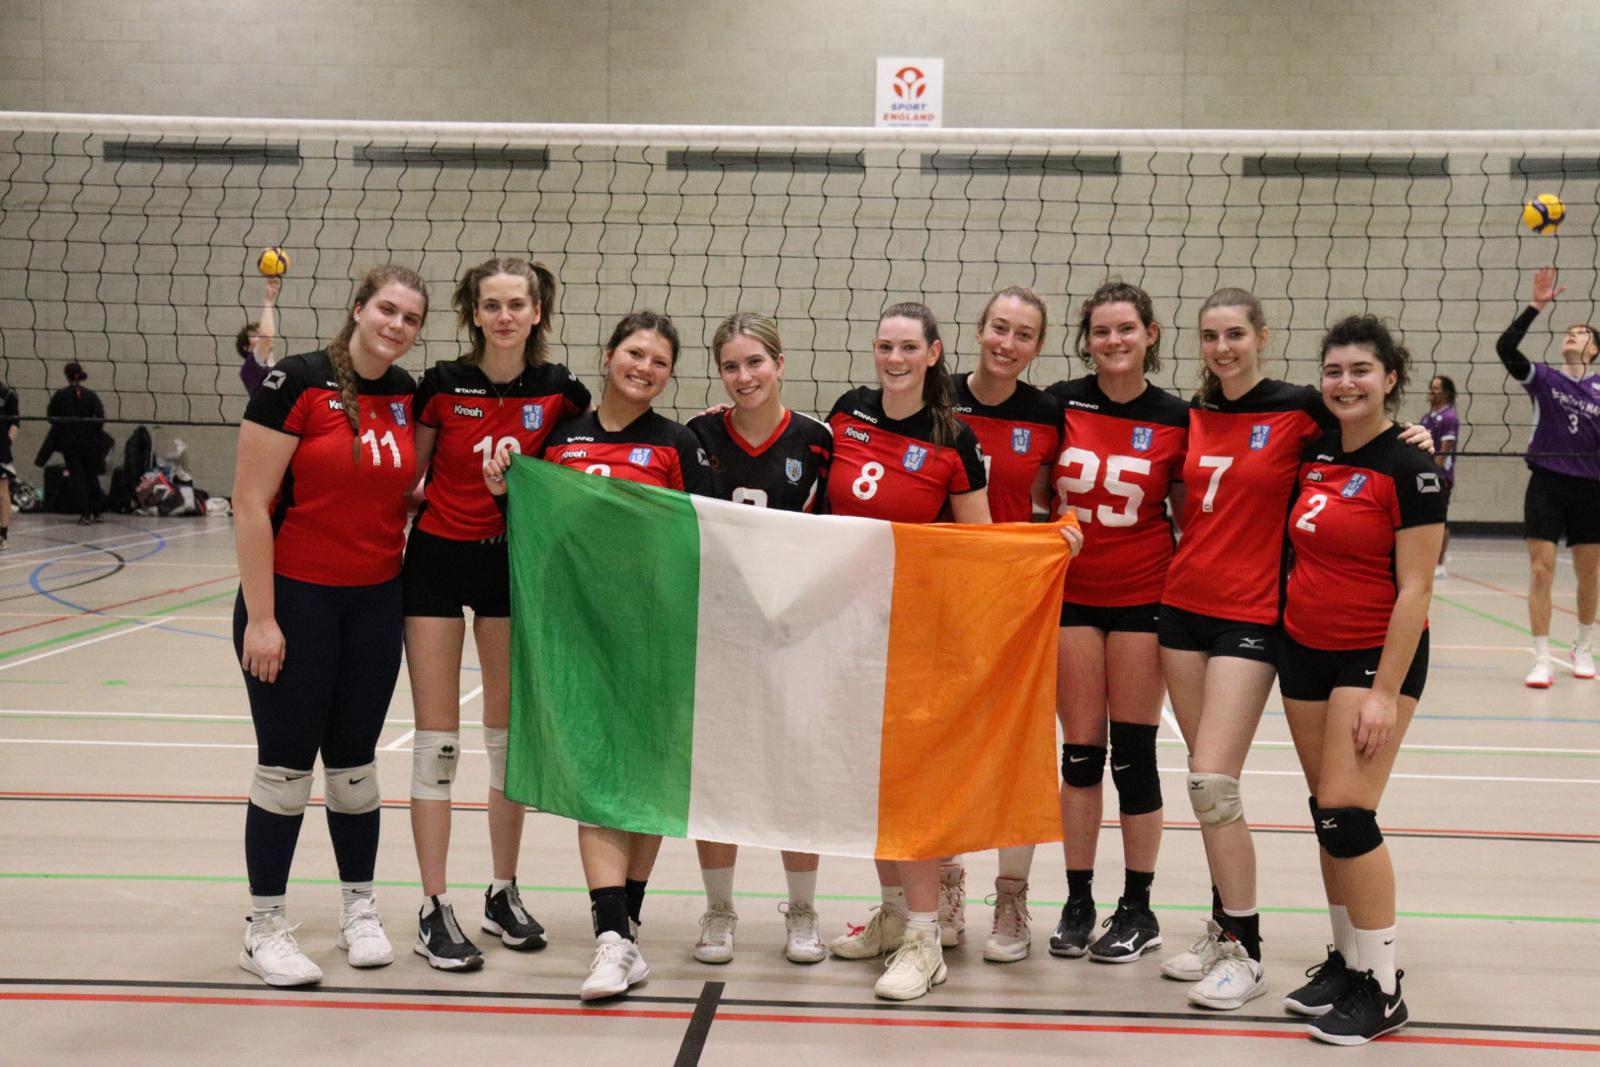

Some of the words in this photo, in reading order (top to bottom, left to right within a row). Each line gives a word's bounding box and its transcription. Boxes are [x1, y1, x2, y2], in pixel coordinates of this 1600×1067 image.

[883, 113, 935, 121] ENGLAND
[892, 103, 926, 111] SPORT
[1568, 414, 1578, 434] 3
[361, 429, 401, 468] 11
[852, 461, 885, 500] 8
[1056, 446, 1152, 527] 25
[1199, 455, 1234, 513] 7
[1296, 494, 1328, 533] 2
